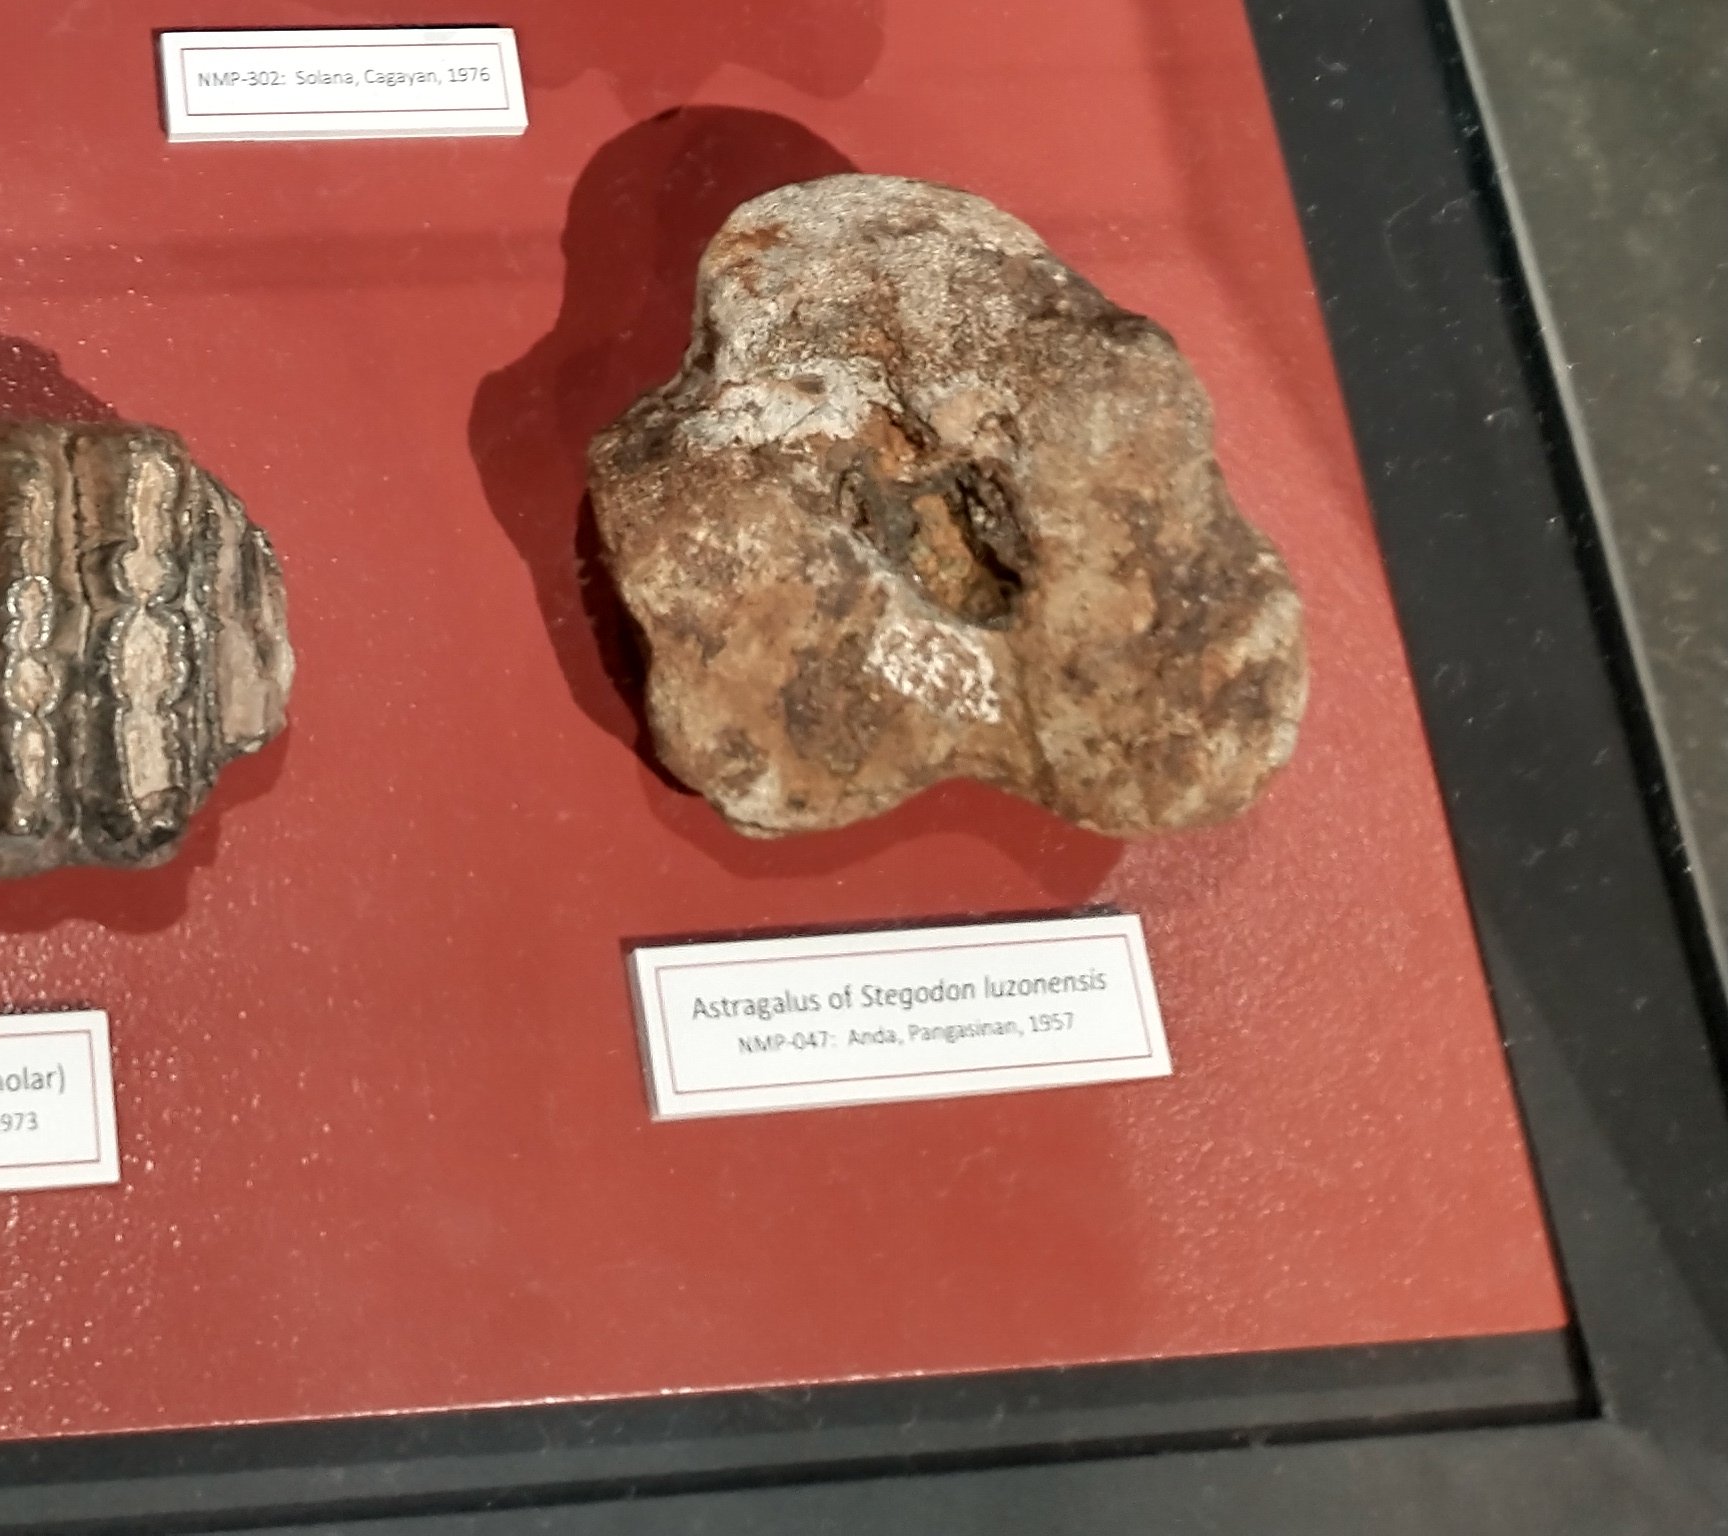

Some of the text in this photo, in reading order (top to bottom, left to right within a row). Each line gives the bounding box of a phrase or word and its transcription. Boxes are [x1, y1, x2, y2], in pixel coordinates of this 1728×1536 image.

[198, 67, 490, 87] NMP-302: Solana, Cagayan, 1976
[692, 969, 1106, 1021] Astragalus of Stegodon luzonensis
[738, 1012, 1074, 1055] NMP-047: Anda, Pangasinan, 1957
